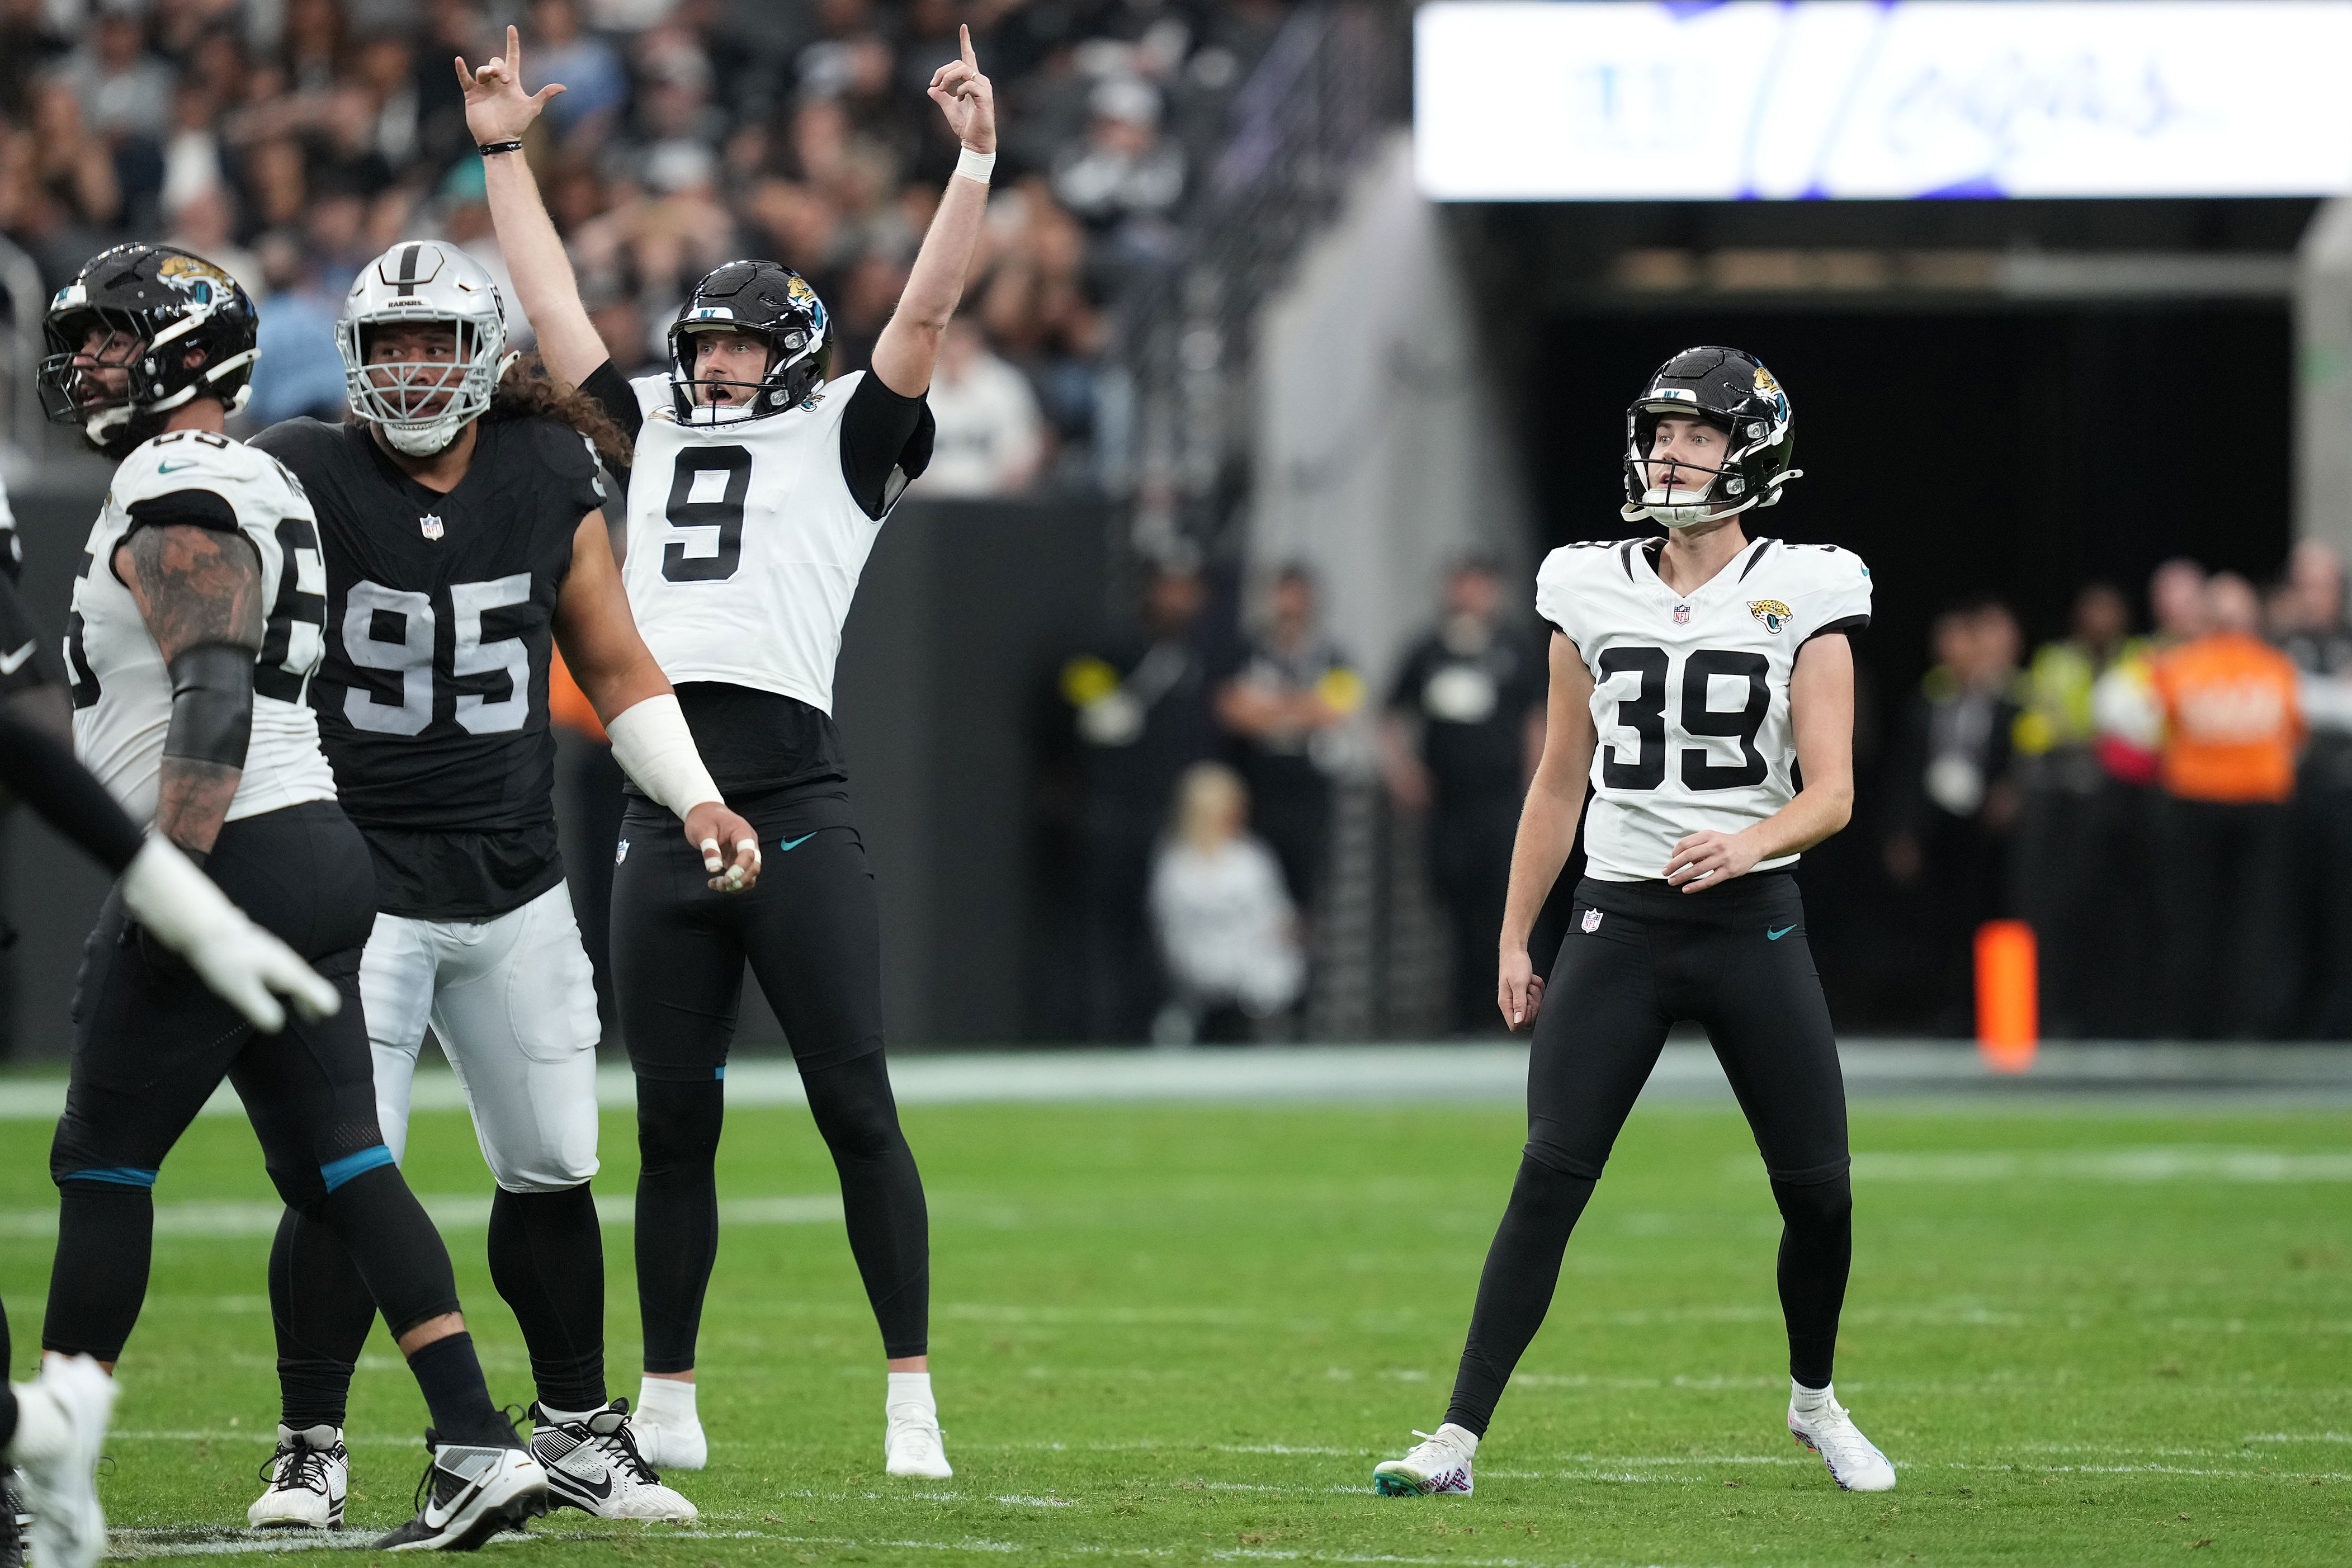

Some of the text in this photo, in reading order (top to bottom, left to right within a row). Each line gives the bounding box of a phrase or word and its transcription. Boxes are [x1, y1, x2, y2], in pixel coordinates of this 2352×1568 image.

[388, 300, 423, 308] RAIDERS
[662, 445, 752, 582] 9
[1675, 612, 1688, 621] NFL
[342, 572, 531, 736] 95
[1597, 647, 1771, 791] 39
[1584, 919, 1596, 928] NFL
